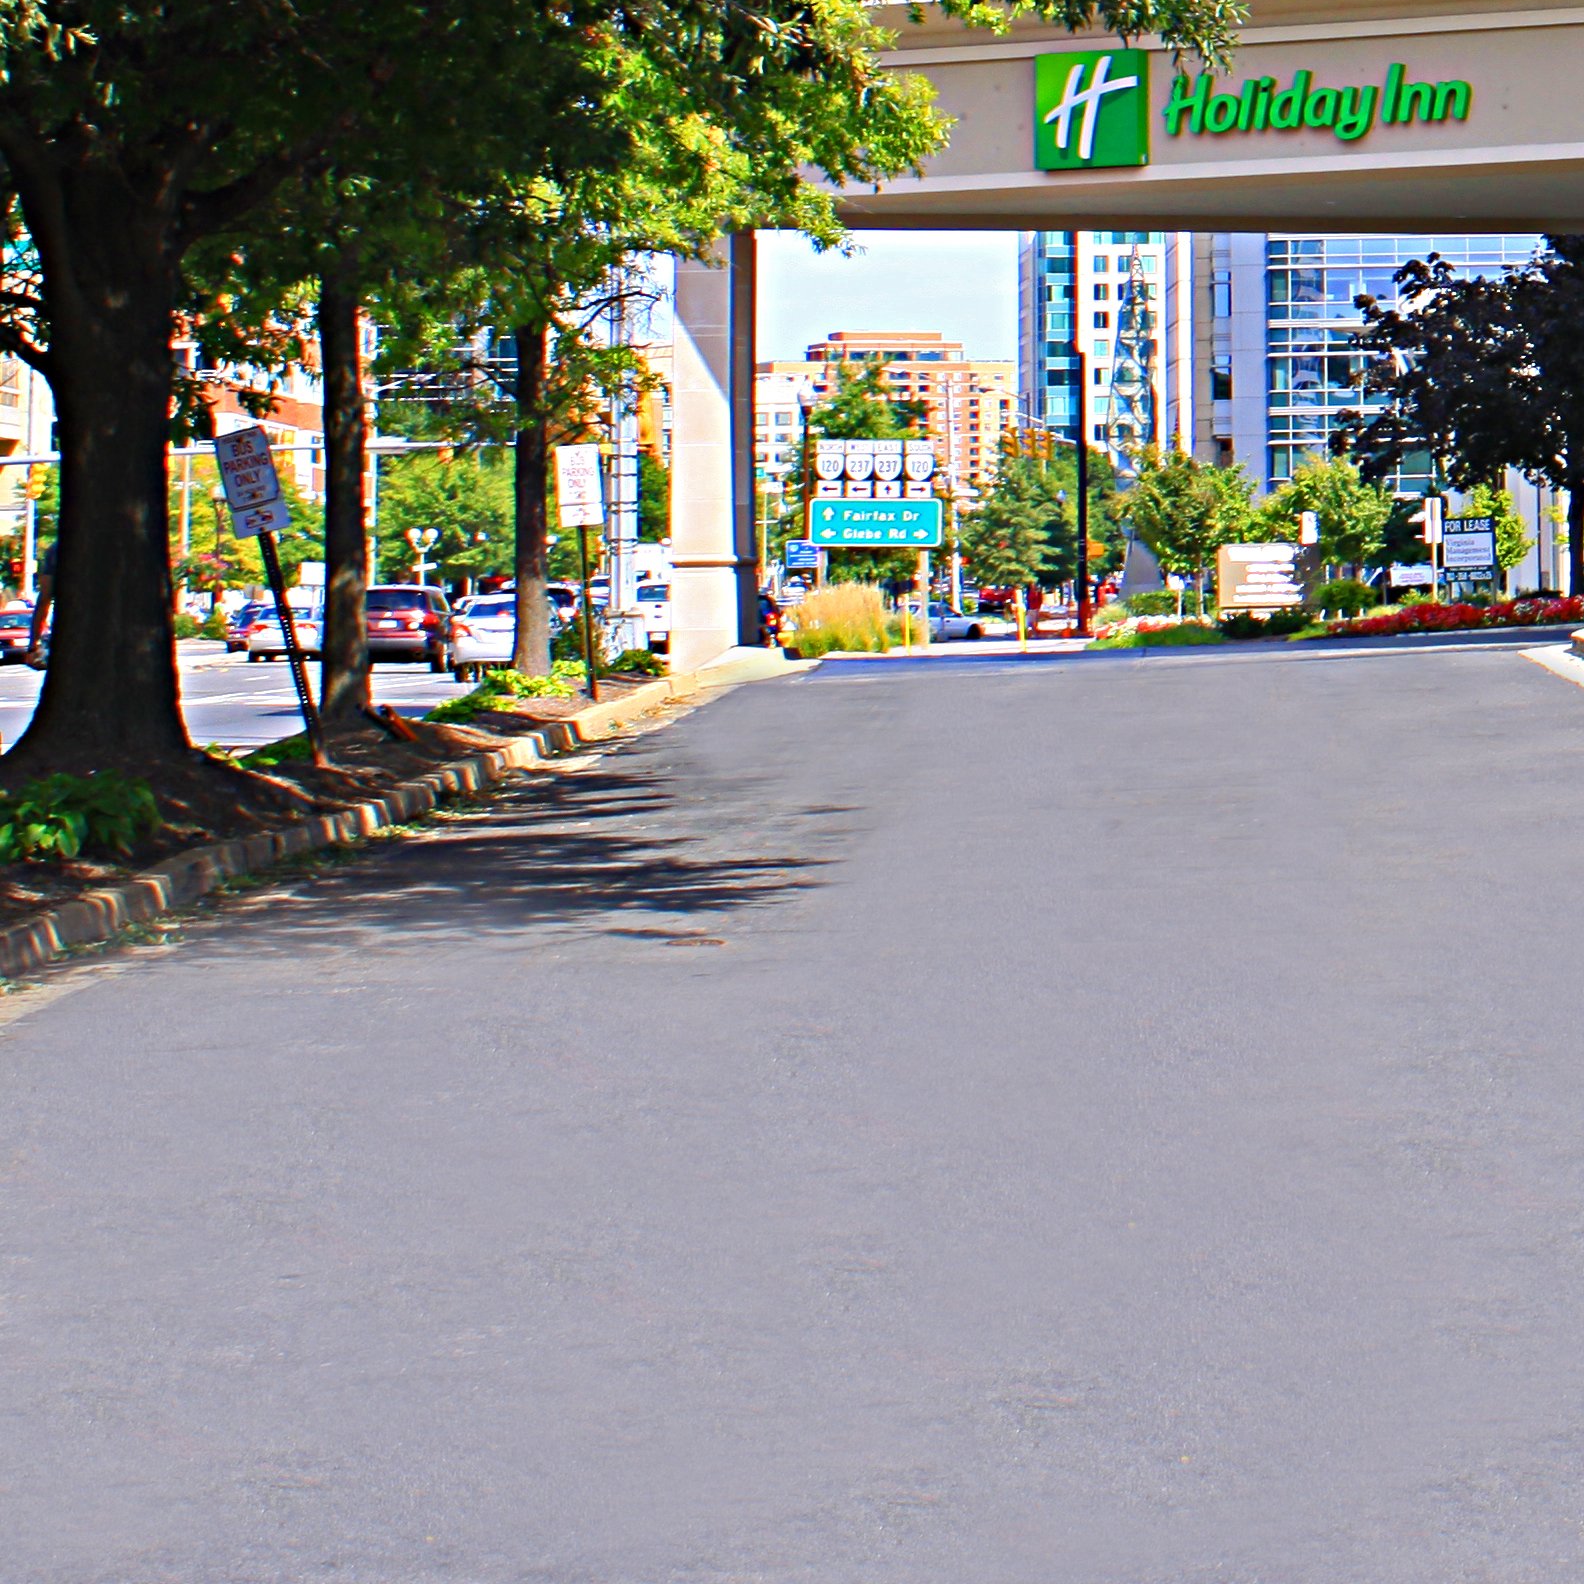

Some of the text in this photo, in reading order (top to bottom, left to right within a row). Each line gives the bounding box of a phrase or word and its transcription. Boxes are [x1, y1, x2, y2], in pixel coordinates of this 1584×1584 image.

[1164, 62, 1472, 141] Holiday Inn
[231, 440, 254, 458] BUS
[877, 443, 899, 452] EAST
[222, 452, 270, 474] PARKING
[821, 459, 840, 473] 120
[850, 460, 871, 473] 237
[878, 460, 899, 473] 237
[911, 460, 929, 473] 120
[234, 469, 261, 488] ONLY
[843, 509, 920, 522] Fairfax Dr
[1445, 518, 1491, 533] FOR LEASE
[842, 528, 908, 539] Glebe Rd
